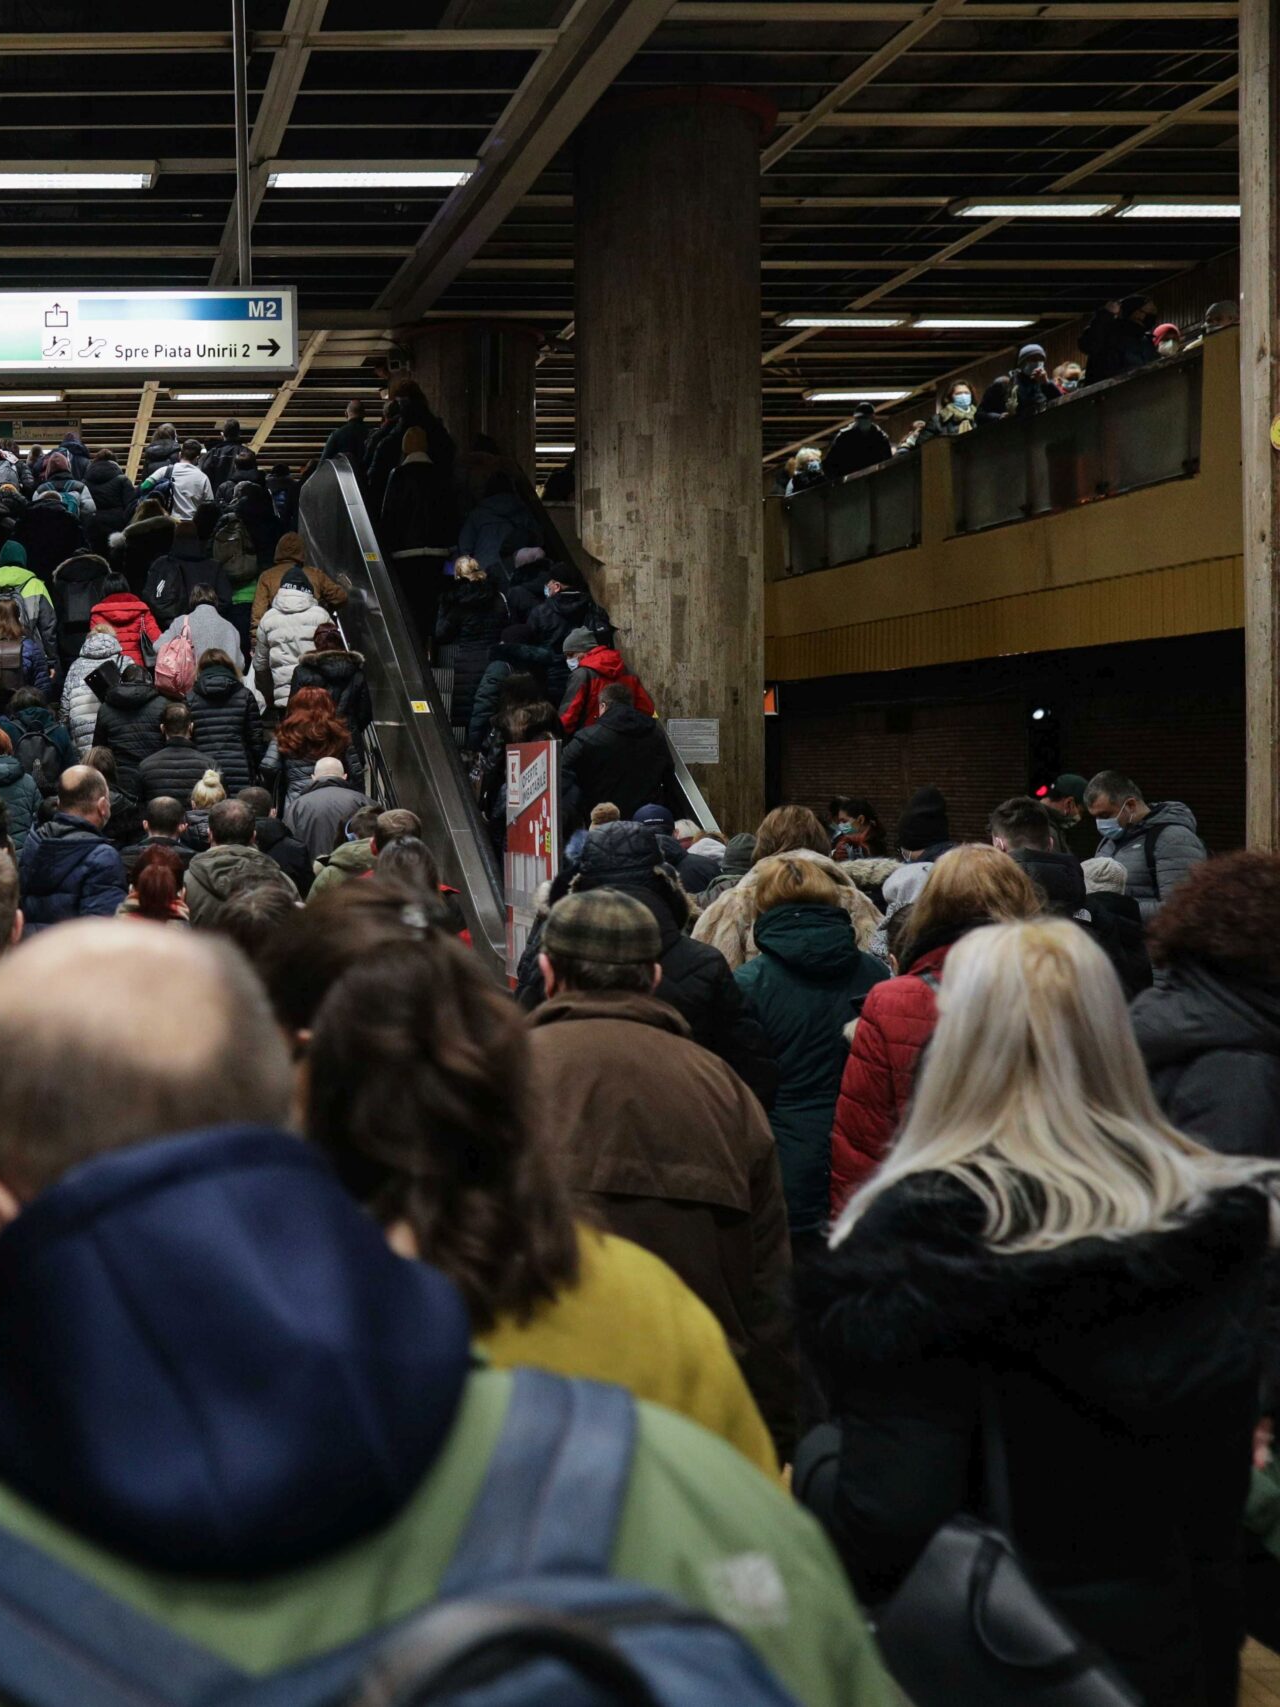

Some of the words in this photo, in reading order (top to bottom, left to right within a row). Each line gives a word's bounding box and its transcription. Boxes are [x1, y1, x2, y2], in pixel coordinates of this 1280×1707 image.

[248, 301, 277, 317] M2
[114, 345, 149, 361] Spre
[154, 344, 191, 358] Piata
[196, 344, 237, 358] Unirii
[242, 344, 250, 358] 2
[522, 763, 538, 788] OFERTE
